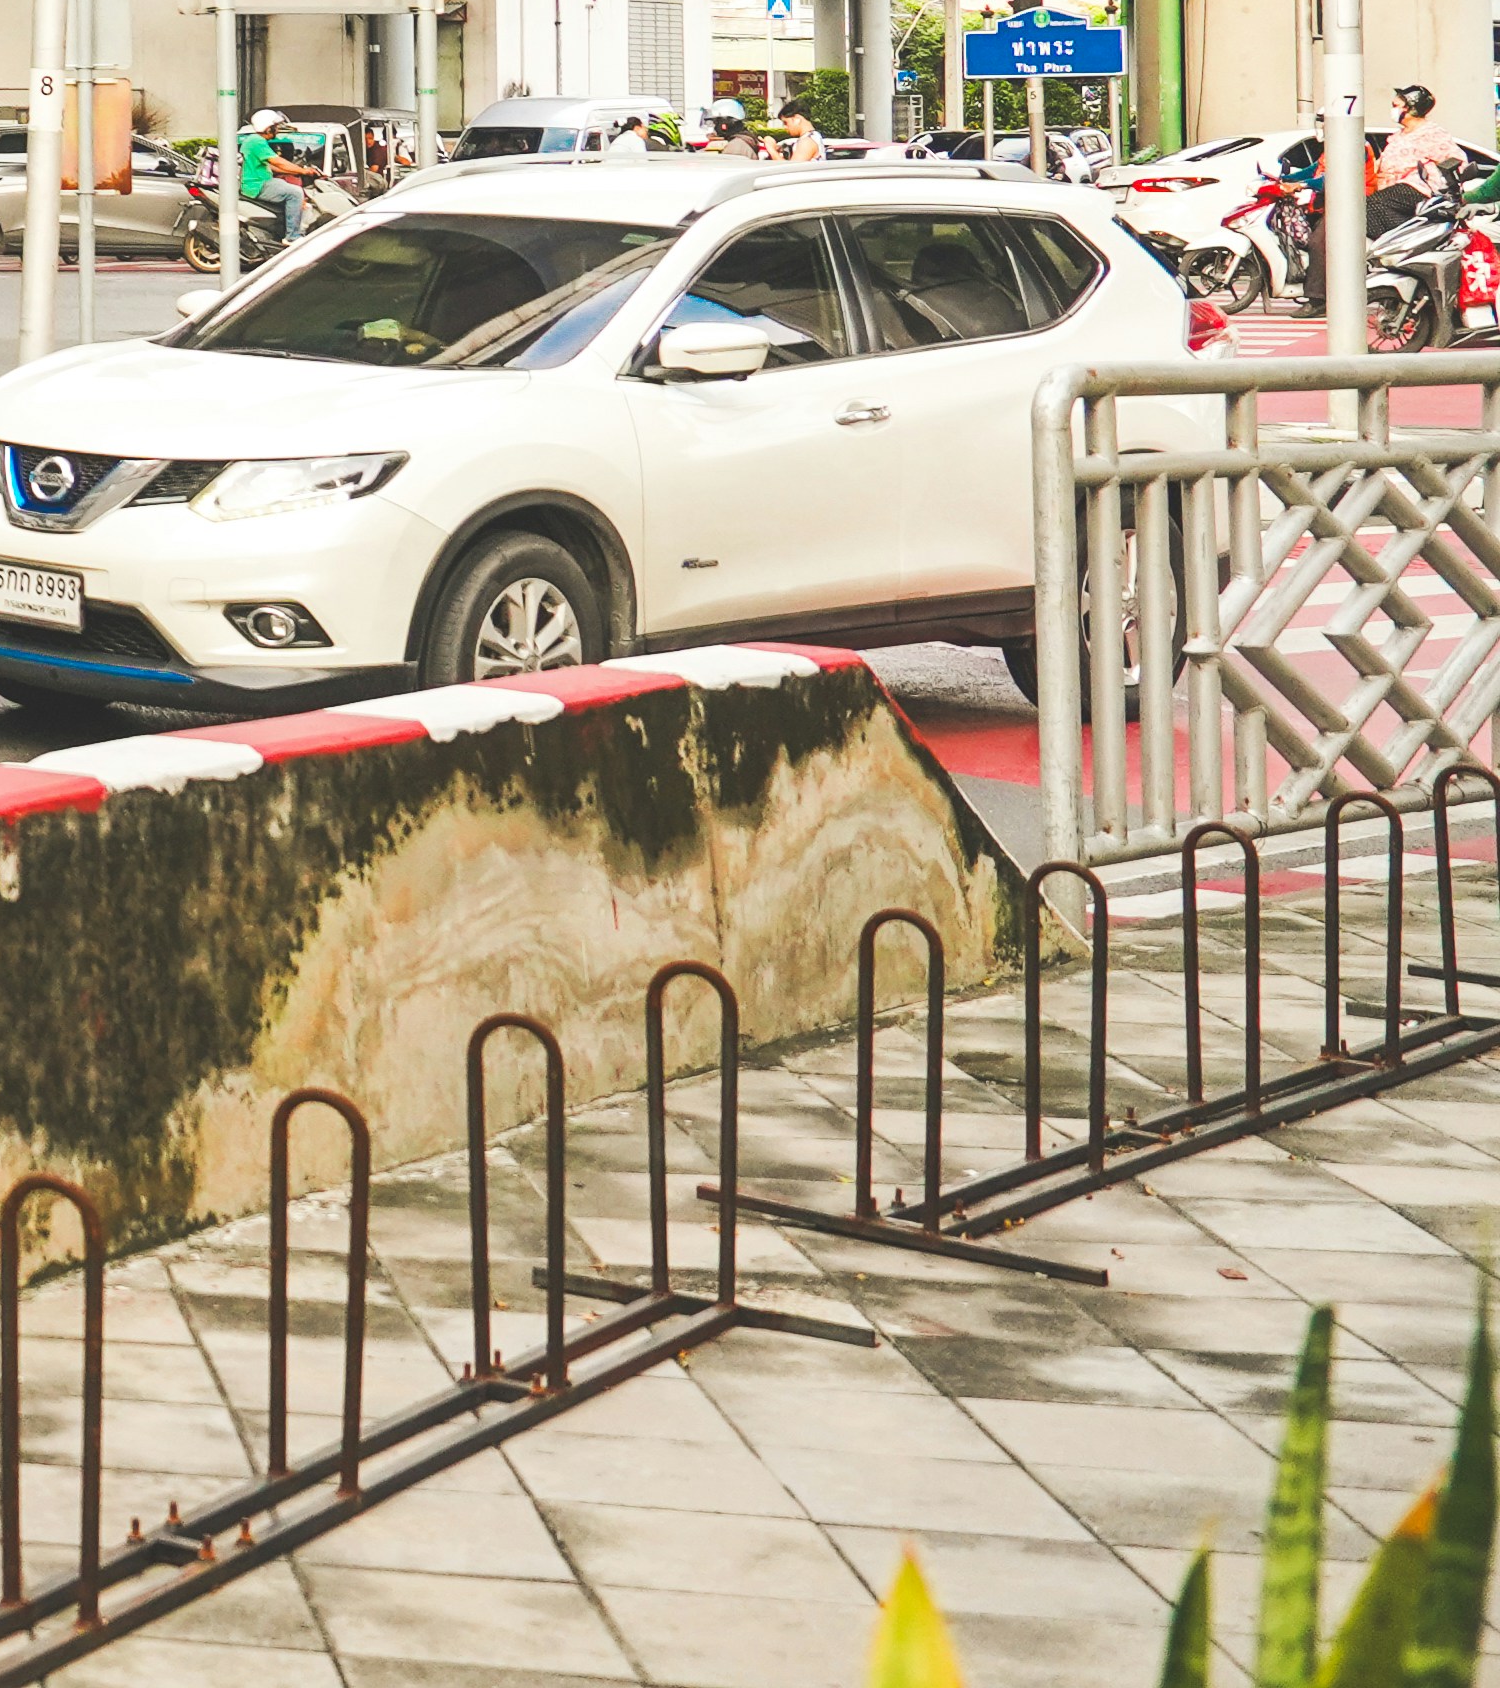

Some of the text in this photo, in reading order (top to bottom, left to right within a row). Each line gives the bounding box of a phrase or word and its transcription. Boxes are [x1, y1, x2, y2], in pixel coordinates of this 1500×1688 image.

[1011, 37, 1074, 57] ท่าพระ
[1016, 63, 1072, 73] Tha Phra
[41, 76, 53, 96] 8
[1030, 91, 1037, 100] 5
[1343, 95, 1357, 115] 7
[35, 574, 77, 601] 8993
